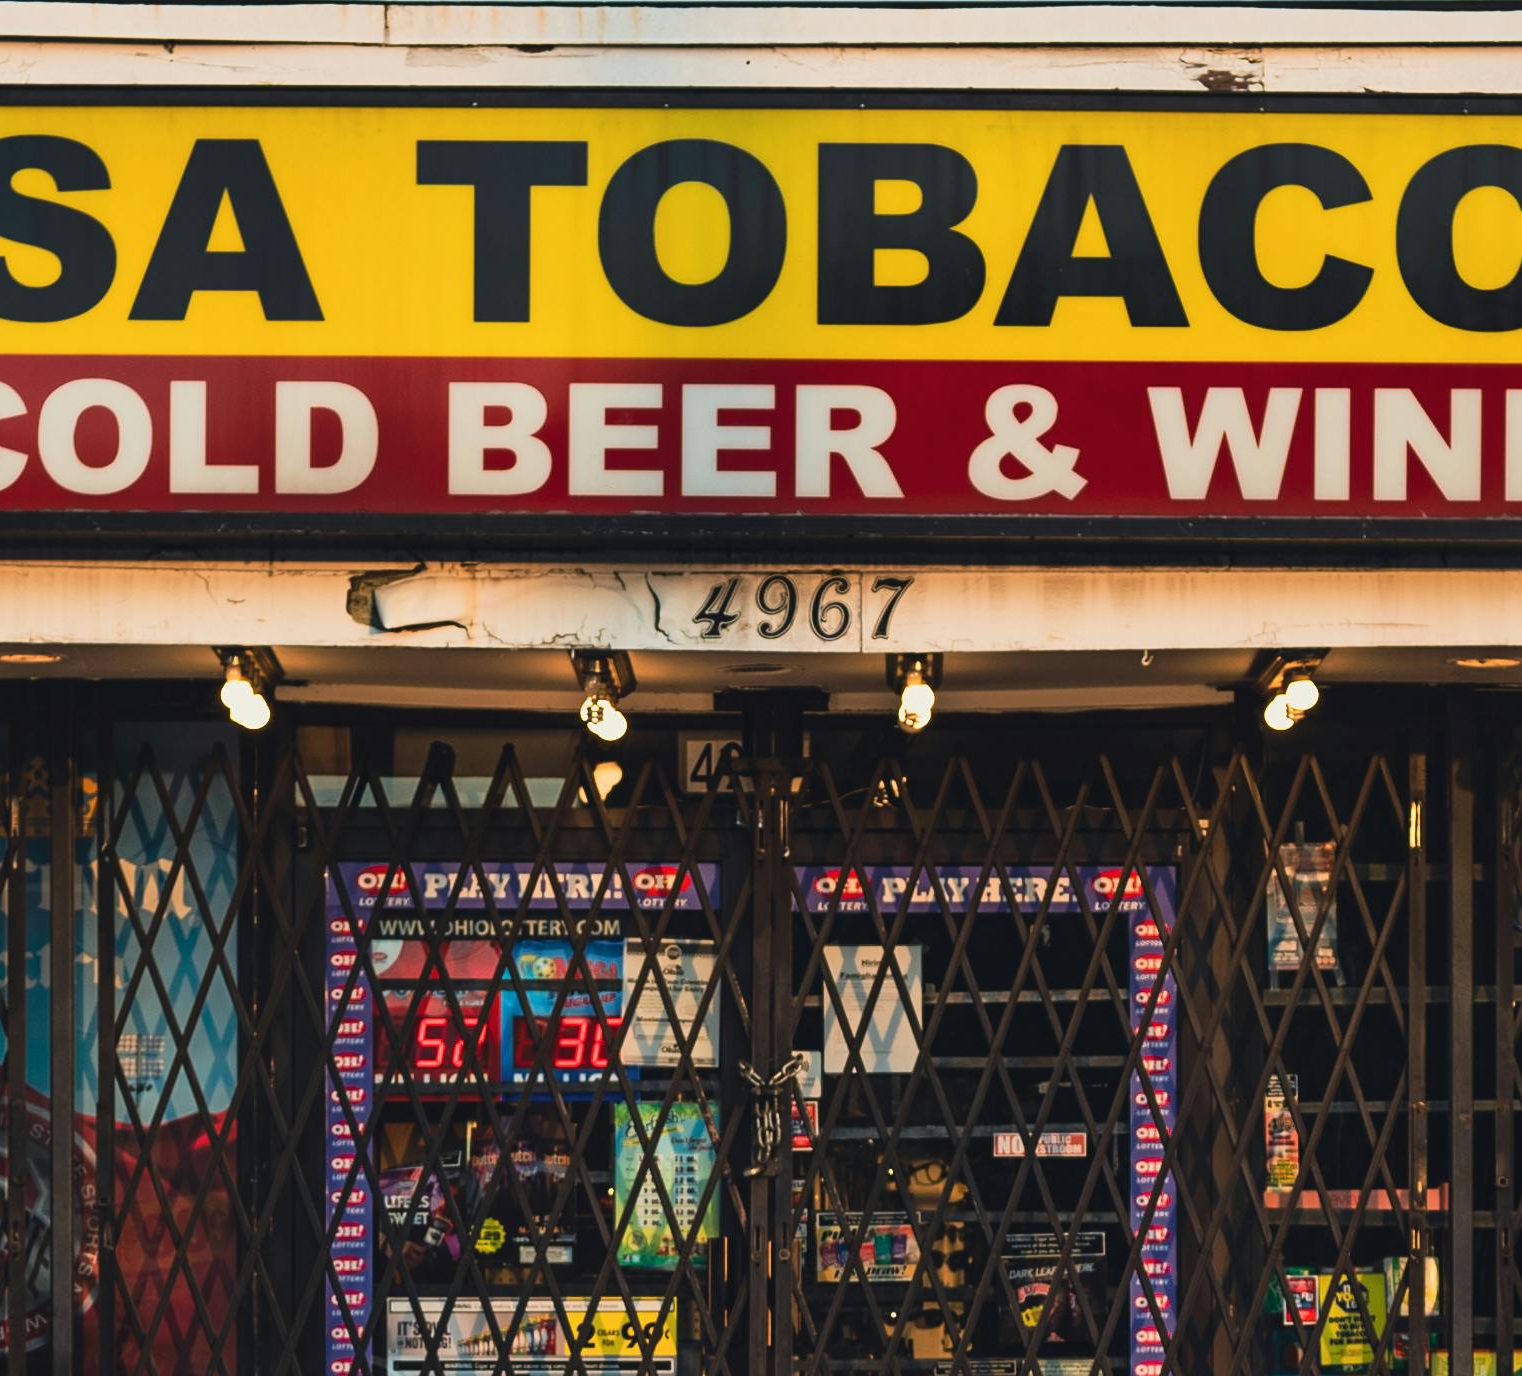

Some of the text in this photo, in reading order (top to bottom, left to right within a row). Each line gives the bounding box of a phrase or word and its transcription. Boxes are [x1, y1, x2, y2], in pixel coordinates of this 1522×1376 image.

[448, 381, 904, 498] BEER
[968, 384, 1088, 501] &
[692, 573, 916, 642] 4967
[634, 870, 689, 891] OH
[379, 919, 622, 937] WWWOHIOLOTTERYCOM
[996, 1134, 1024, 1155] NO
[1029, 1144, 1083, 1155] STROOM
